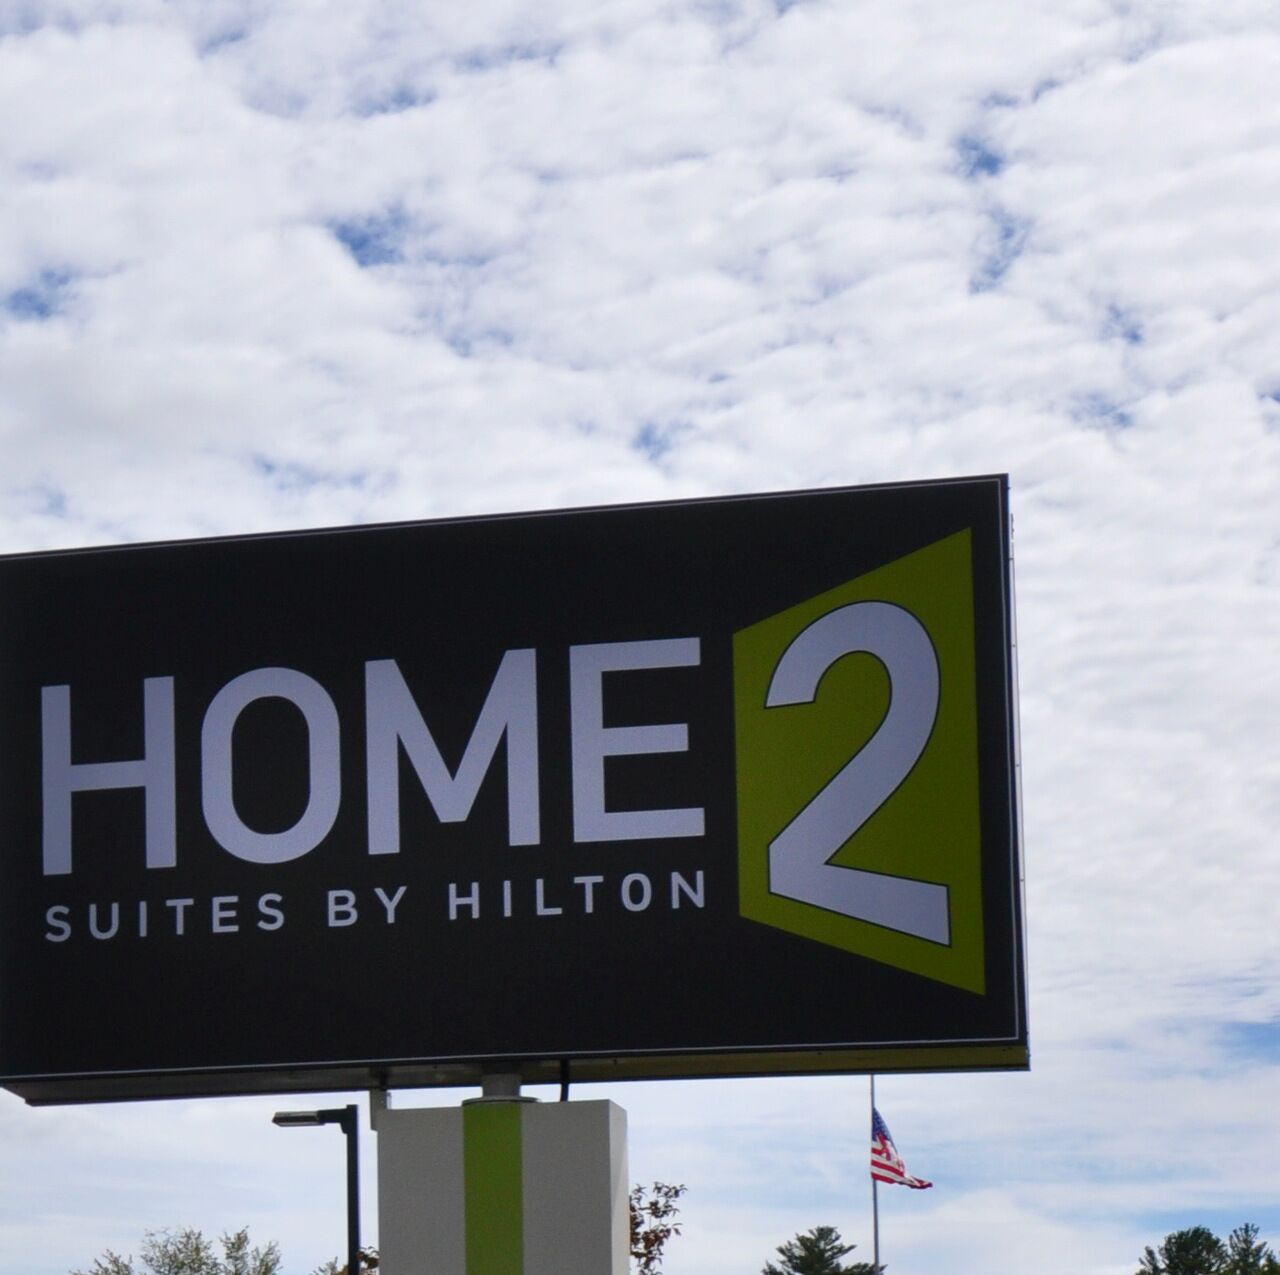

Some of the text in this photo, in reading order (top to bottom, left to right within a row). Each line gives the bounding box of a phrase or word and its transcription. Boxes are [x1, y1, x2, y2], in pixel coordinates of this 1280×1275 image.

[43, 870, 707, 944] SUITES BY HILTON
